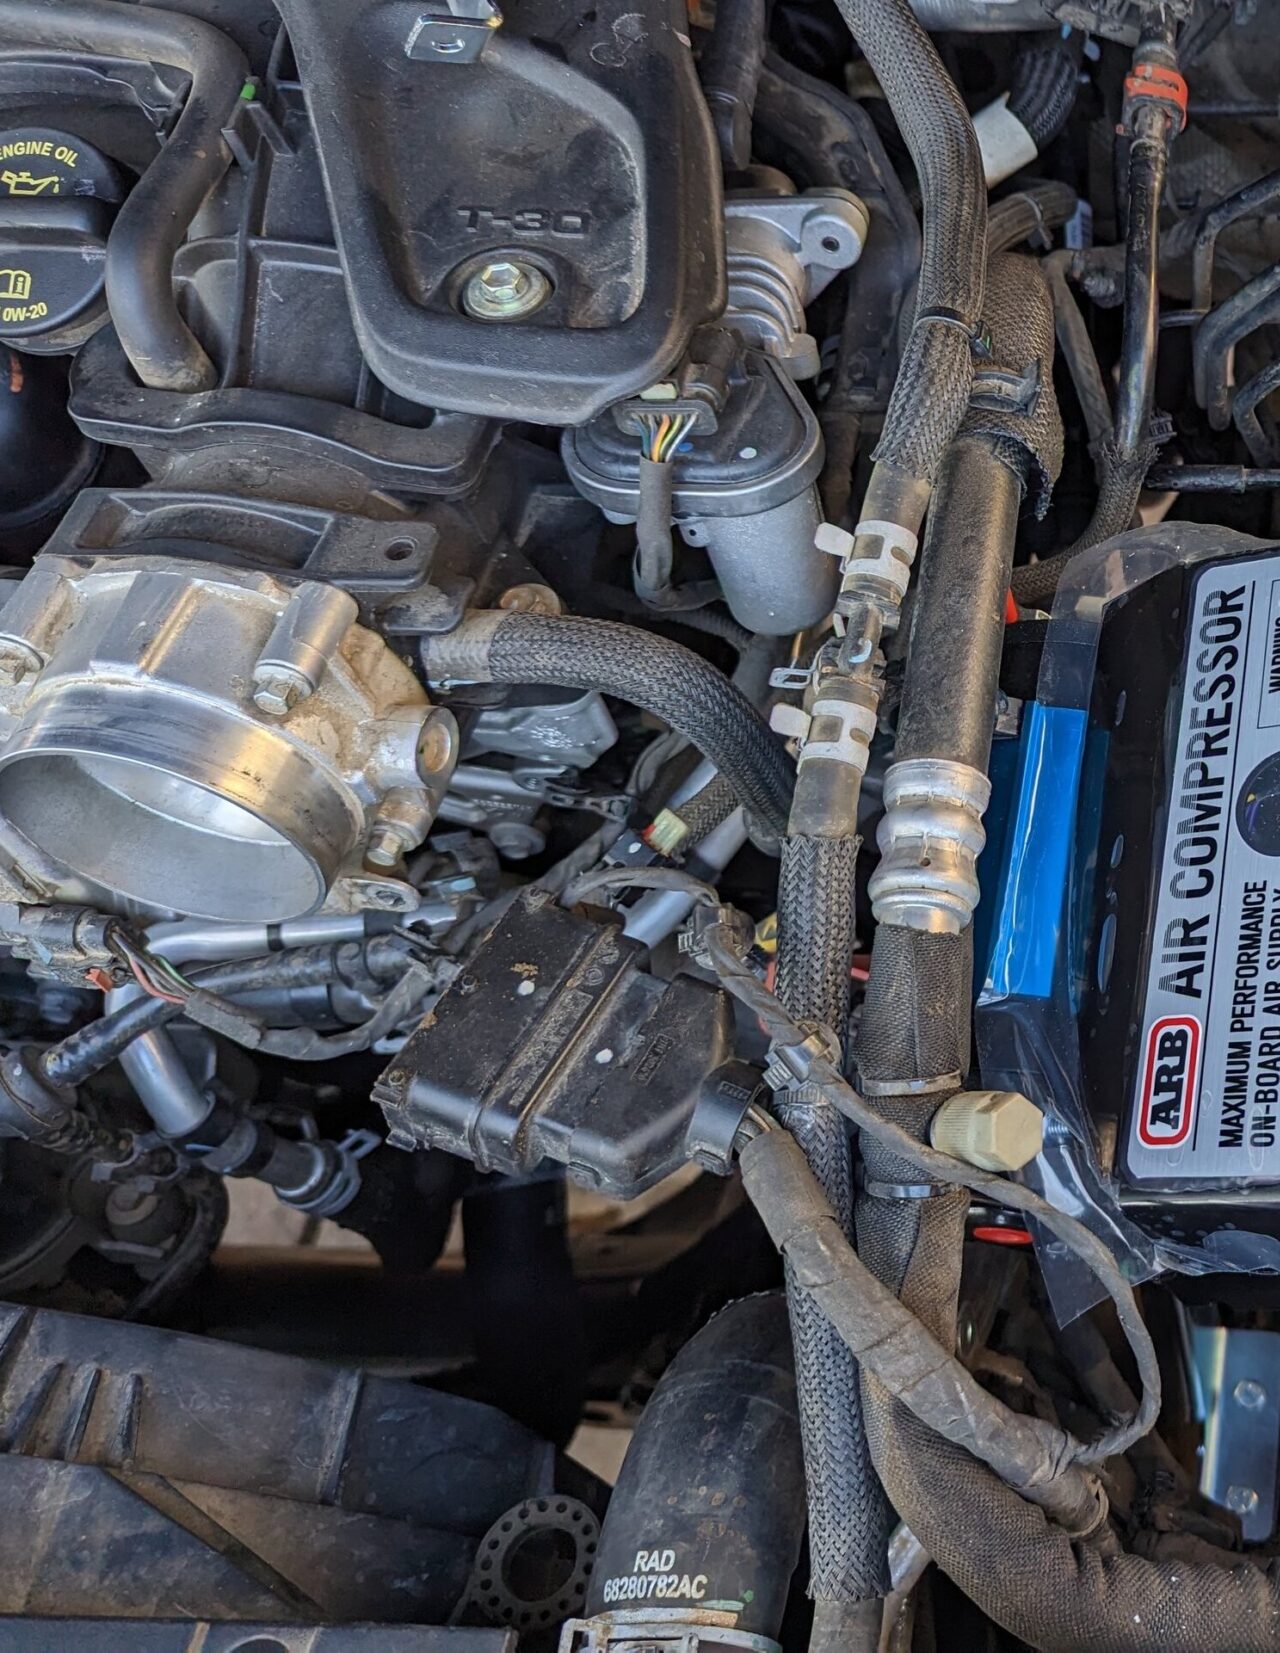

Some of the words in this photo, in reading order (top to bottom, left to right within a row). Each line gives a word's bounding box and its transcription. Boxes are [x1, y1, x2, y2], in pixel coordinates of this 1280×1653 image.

[55, 146, 79, 167] OIL
[456, 204, 591, 239] T-30
[2, 302, 48, 322] 0W-20
[1170, 585, 1247, 899] COMPRESSOR
[1158, 914, 1210, 999] AIR
[1229, 880, 1268, 1032] PERFORMANCE
[1150, 1028, 1189, 1130] ARB
[1218, 1041, 1252, 1148] MAXIMUM
[603, 1574, 708, 1603] 68280782AC
[633, 1549, 676, 1573] RAD
